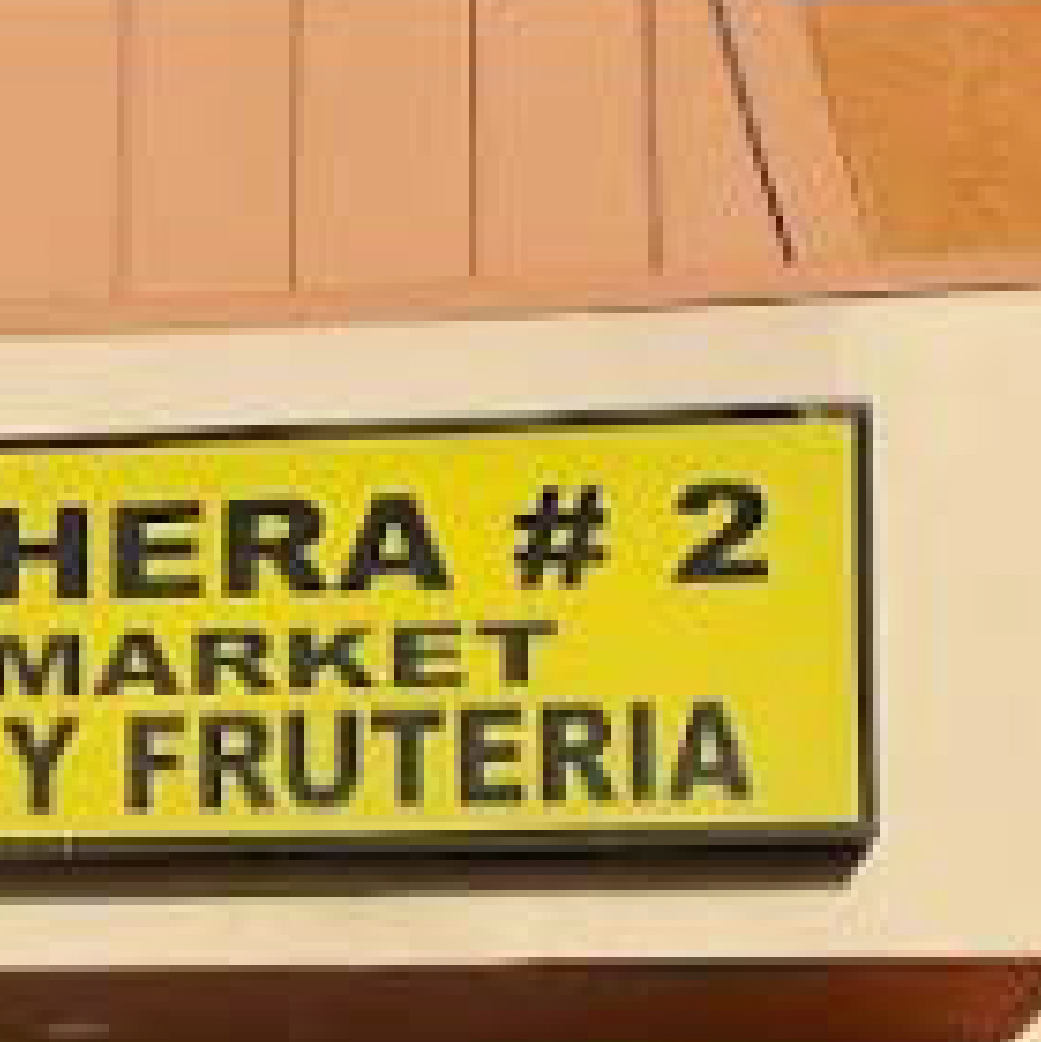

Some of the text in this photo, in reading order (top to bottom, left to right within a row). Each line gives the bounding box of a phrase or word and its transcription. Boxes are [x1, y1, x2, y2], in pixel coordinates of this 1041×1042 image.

[514, 484, 606, 587] #
[672, 479, 770, 584] 2
[3, 716, 78, 816] Y
[125, 702, 753, 812] FRUTERIA
